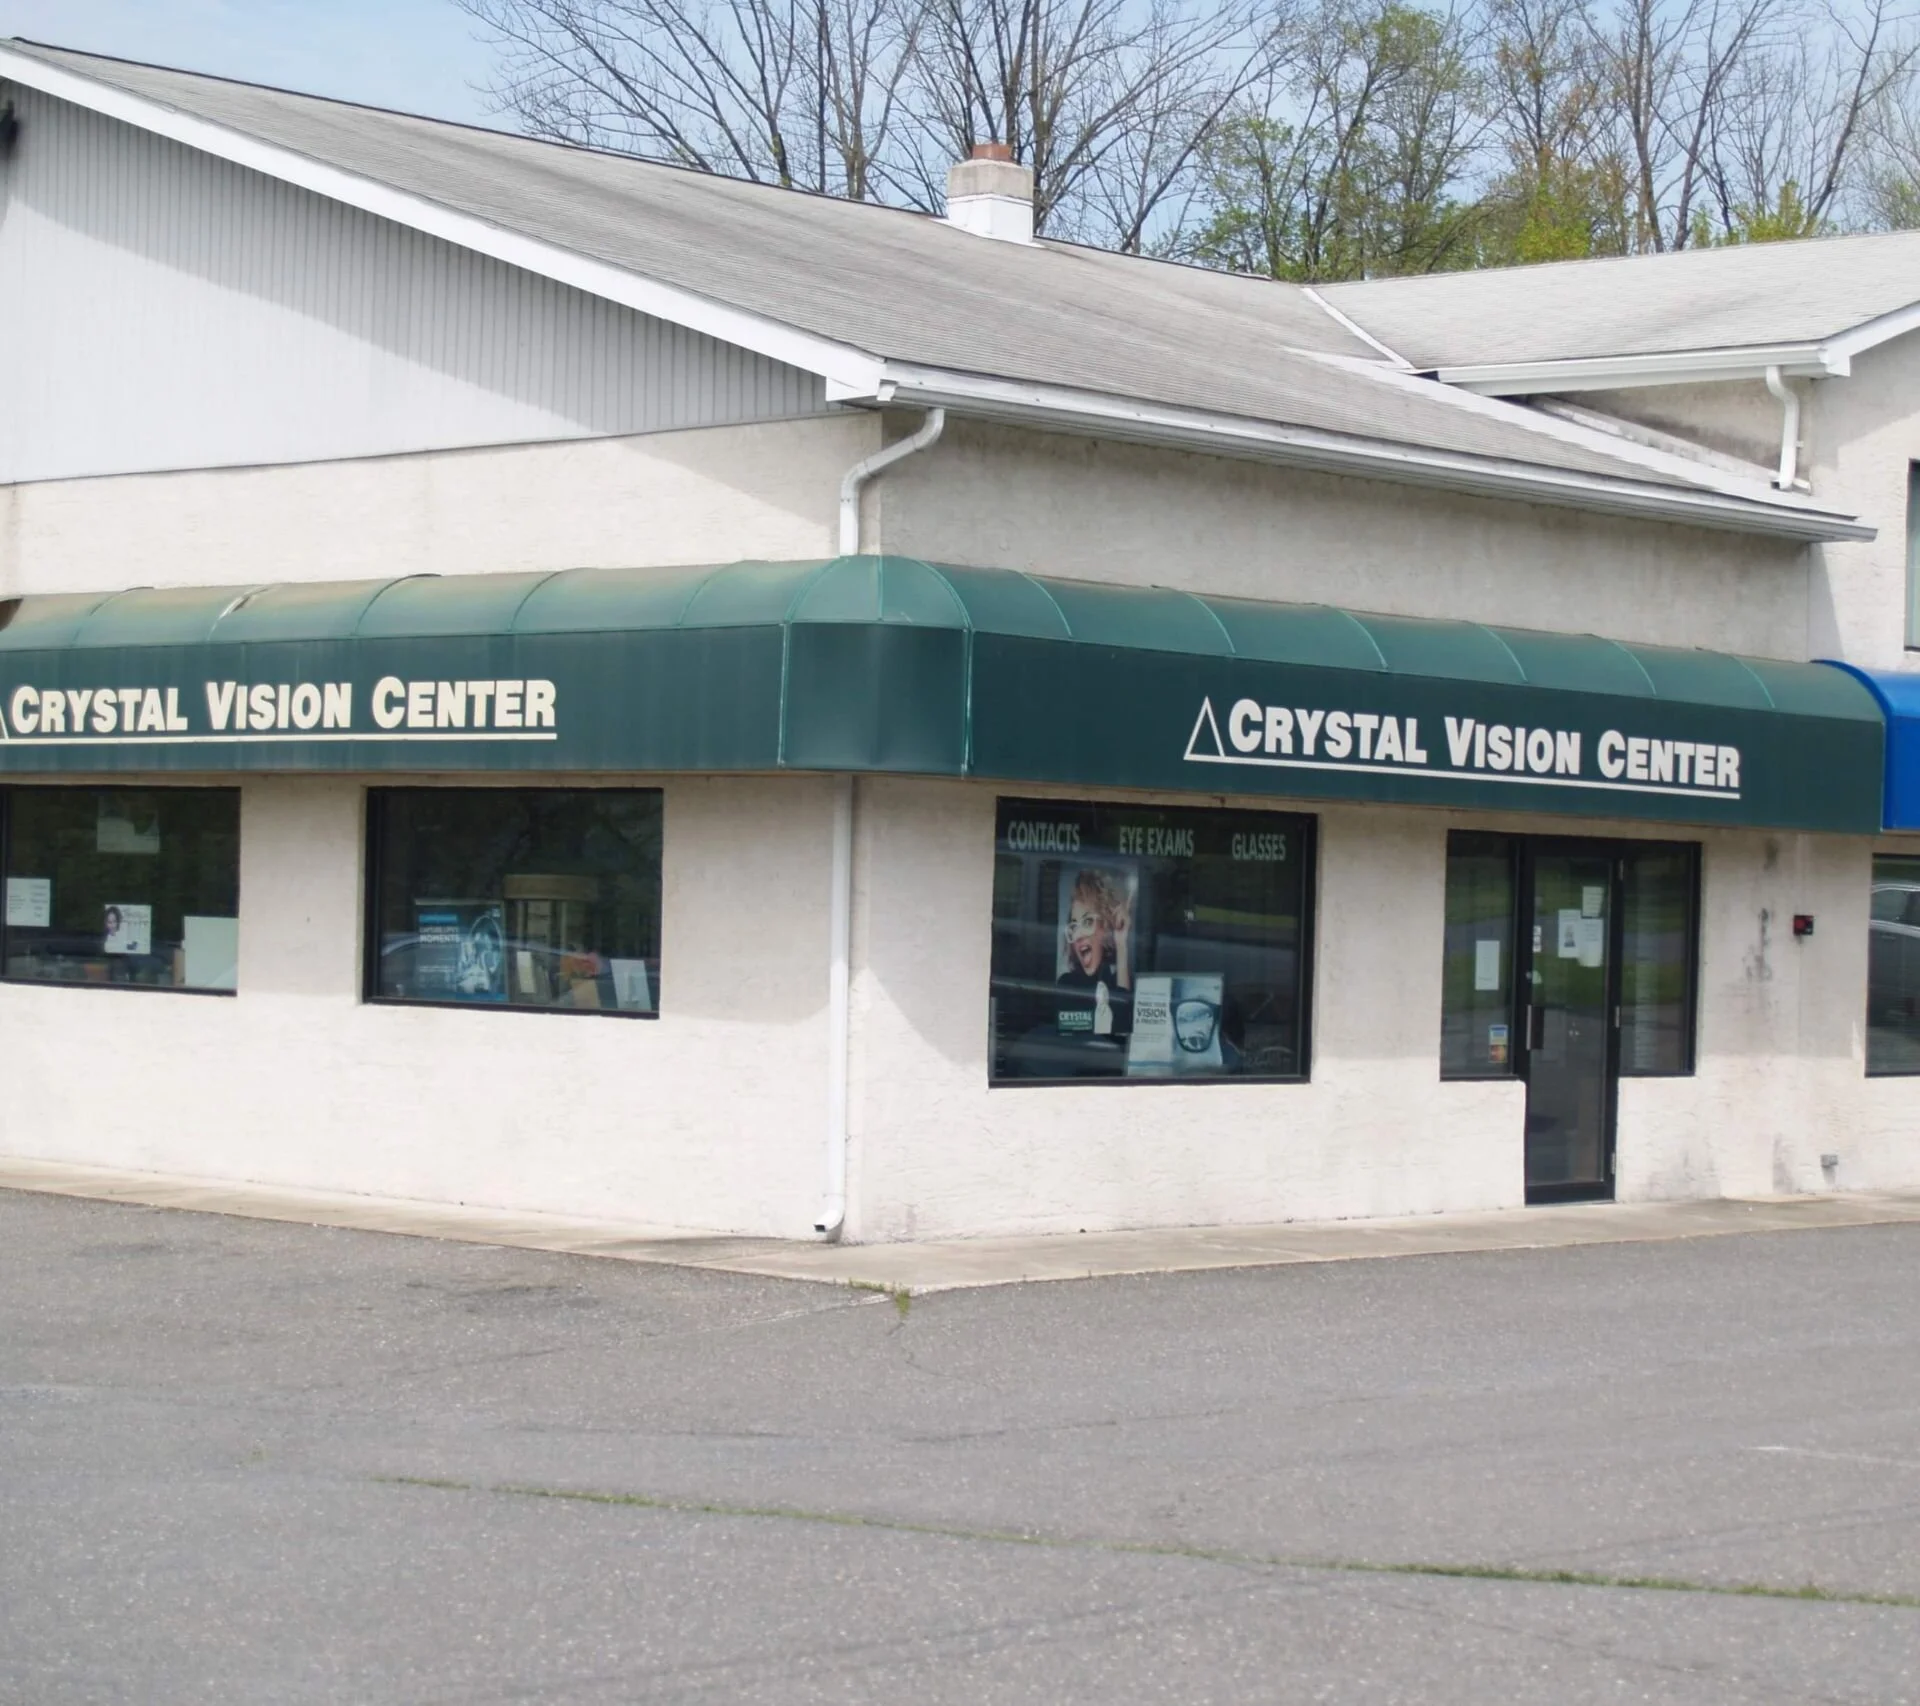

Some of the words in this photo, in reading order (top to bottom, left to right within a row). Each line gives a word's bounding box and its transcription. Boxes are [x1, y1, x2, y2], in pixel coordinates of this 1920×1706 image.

[12, 686, 188, 733] CRYSTAL
[206, 681, 352, 730] VISION
[372, 677, 557, 729] CENTER
[1228, 698, 1427, 764] CRYSTAL
[1444, 716, 1581, 775] VISION
[1597, 730, 1740, 788] CENTER
[1007, 820, 1080, 852] CONTACTS
[1119, 826, 1143, 855] EYE
[1147, 828, 1195, 857] EXAMS
[1231, 833, 1287, 861] GLASSES
[1137, 1007, 1167, 1018] VISION
